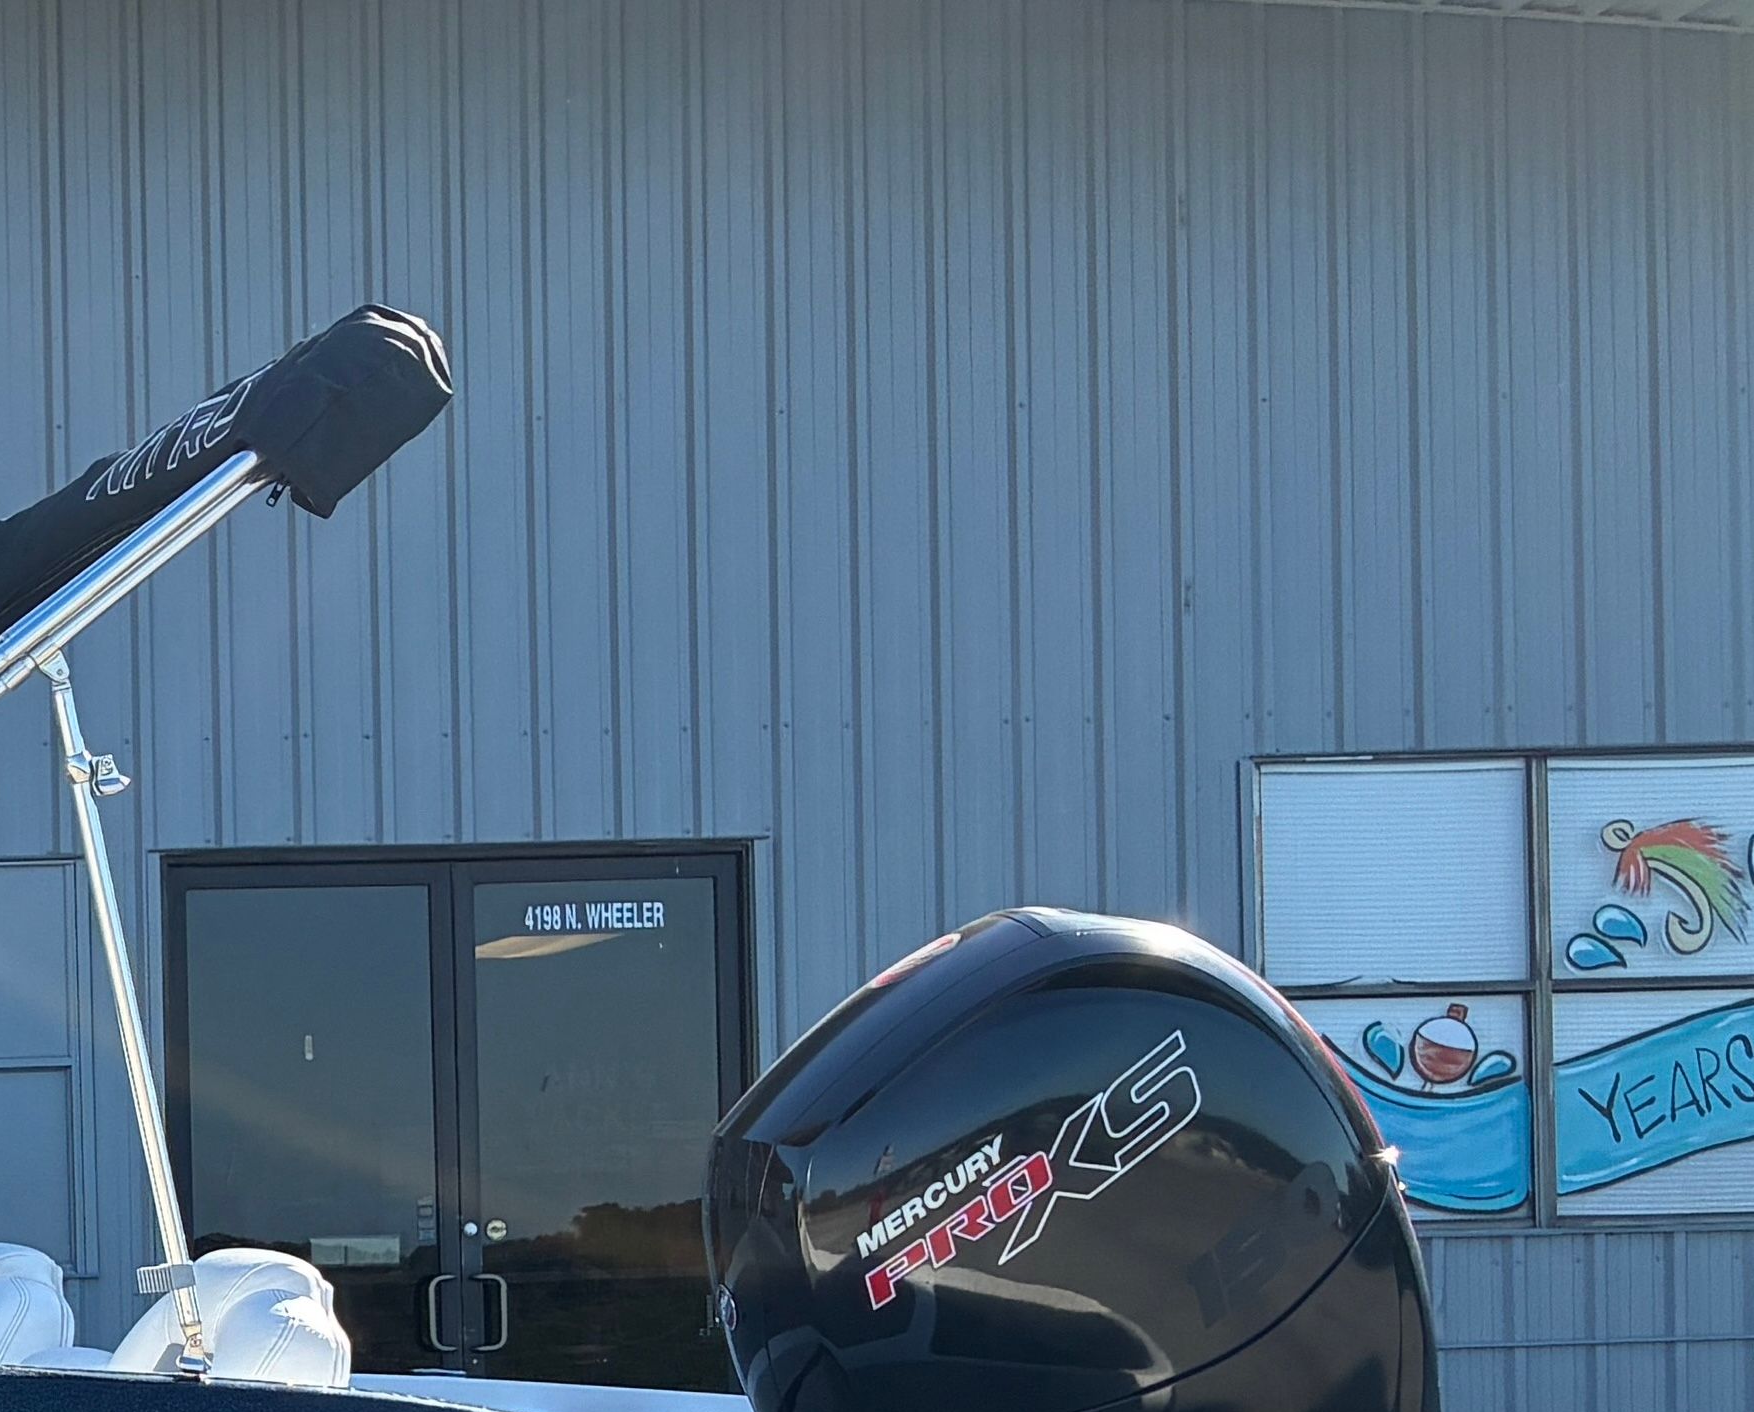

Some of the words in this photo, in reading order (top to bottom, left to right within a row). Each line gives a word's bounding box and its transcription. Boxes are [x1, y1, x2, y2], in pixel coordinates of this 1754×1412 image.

[524, 905, 561, 931] 4198
[565, 903, 582, 930] N.
[585, 901, 665, 929] WHEELER
[1578, 1034, 1754, 1143] YEARS
[856, 1133, 1004, 1260] MERCURY
